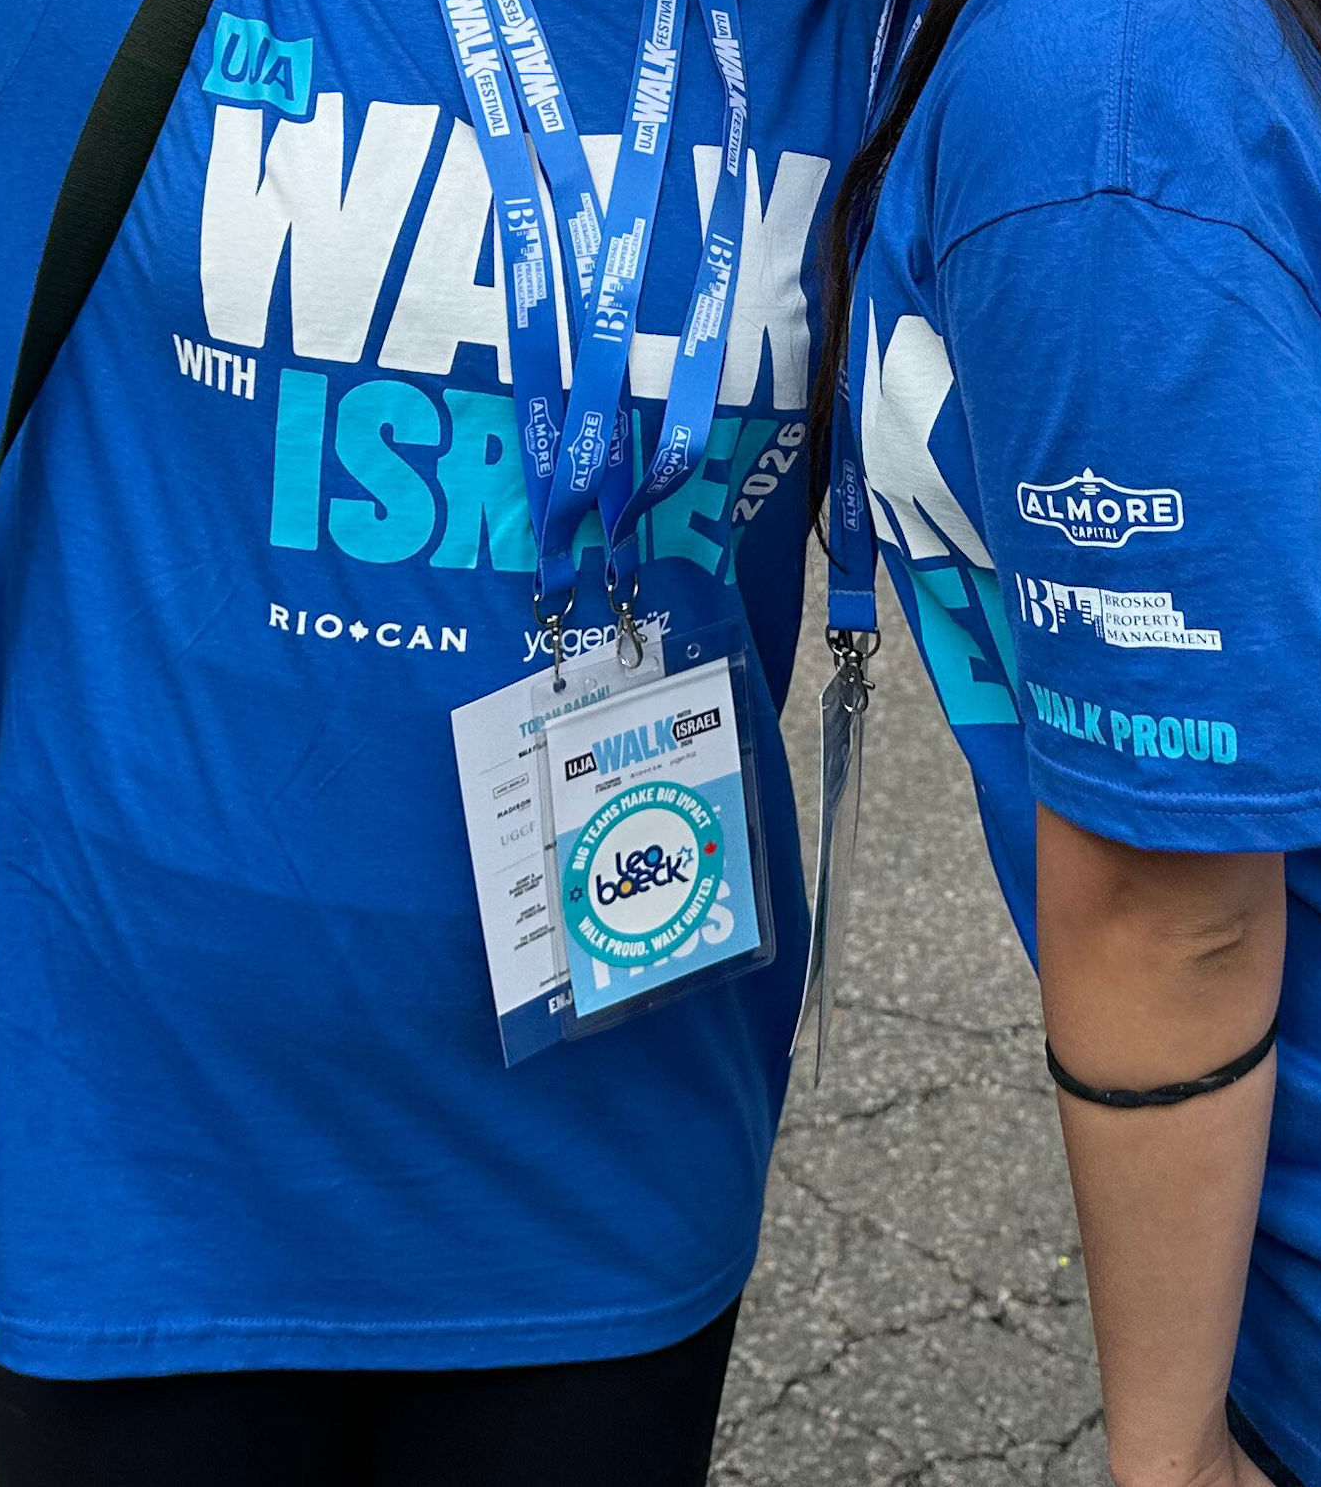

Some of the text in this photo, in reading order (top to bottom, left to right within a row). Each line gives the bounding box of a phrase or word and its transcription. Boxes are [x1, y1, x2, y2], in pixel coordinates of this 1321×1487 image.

[219, 31, 296, 103] UJA
[499, 17, 560, 107] WALK
[632, 39, 677, 123] WALK
[712, 14, 748, 170] UJA WALK FESTIVAL
[478, 74, 505, 132] FESTIVAL
[541, 101, 559, 128] UJA
[639, 124, 655, 150] UJA
[174, 333, 257, 400] WITH
[533, 401, 551, 474] ALMORE
[574, 415, 599, 488] ALMORE
[652, 430, 687, 492] ALMORE
[732, 422, 807, 523] 2026
[846, 466, 857, 528] ALMORE
[1026, 492, 1175, 524] ALMORE
[1071, 526, 1119, 540] CAPITAL
[1104, 594, 1167, 609] BROSKO
[1105, 612, 1180, 627] PROPERTY
[523, 623, 618, 663] yogen
[1106, 630, 1219, 646] MANAGEMENT
[568, 754, 596, 777] UJA
[592, 715, 678, 776] WALK
[675, 711, 719, 738] ISRAEL
[1026, 681, 1238, 765] WALK PROUD
[572, 846, 591, 871] BIG
[585, 804, 621, 848] TEAMS
[620, 786, 655, 811] MAKE
[656, 786, 678, 803] BIG
[676, 790, 712, 830] IMPACT
[596, 855, 690, 906] baeck
[615, 844, 663, 877] leo
[578, 915, 607, 953] WALK
[605, 939, 650, 959] PROUD.
[650, 923, 687, 952] WALK
[682, 873, 716, 926] UNITED.
